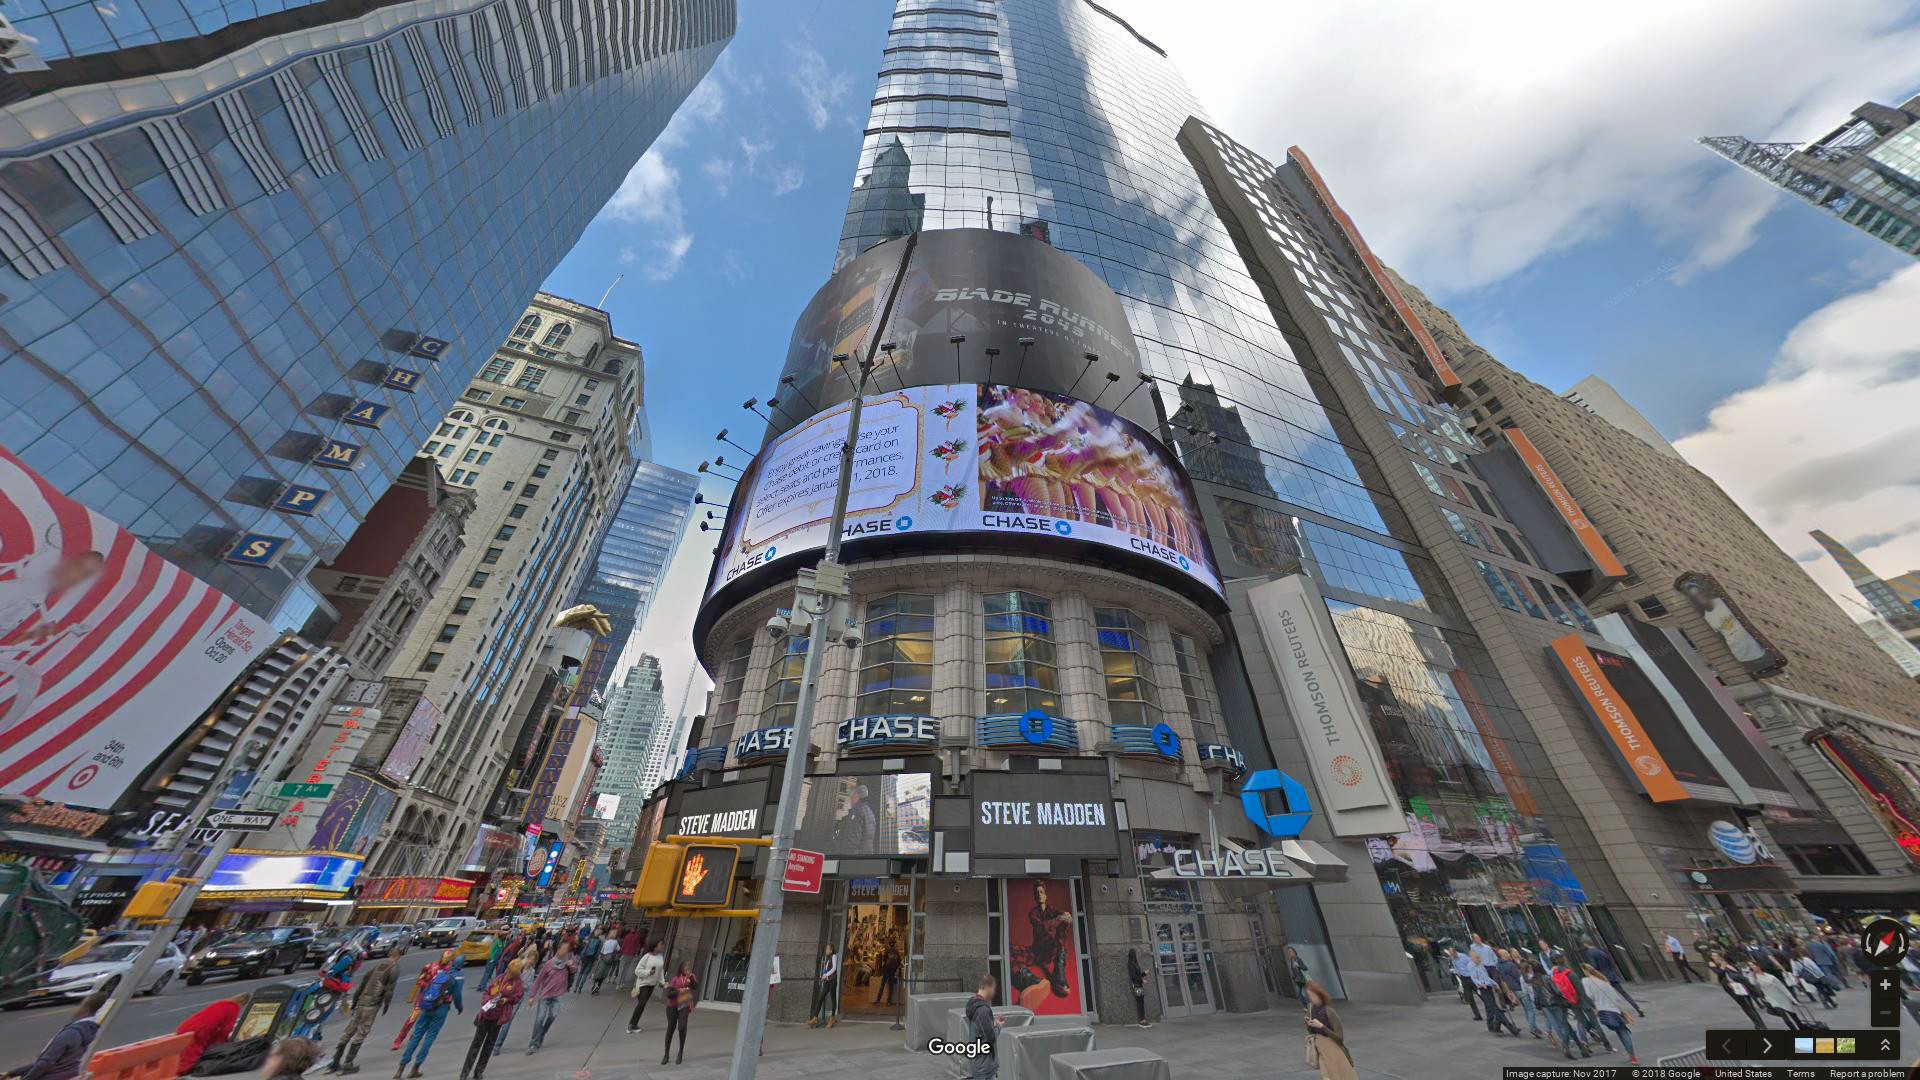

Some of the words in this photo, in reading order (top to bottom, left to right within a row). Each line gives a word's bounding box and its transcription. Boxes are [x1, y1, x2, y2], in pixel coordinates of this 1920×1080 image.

[856, 440, 881, 453] card
[884, 438, 899, 449] on
[857, 431, 873, 441] se
[874, 425, 900, 441] your
[802, 467, 821, 484] and
[809, 479, 839, 497] Janua
[865, 465, 898, 480] 2018.
[841, 519, 893, 537] HASE
[982, 514, 1053, 532] CHASE
[1130, 537, 1179, 565] CHASE
[726, 553, 764, 582] CHASE
[214, 636, 236, 656] Opens
[1278, 608, 1310, 669] REUTERS
[1572, 655, 1605, 698] REUTERS
[1302, 670, 1340, 747] THOMSON
[837, 716, 937, 746] CHASE
[1599, 698, 1641, 751] THOMSON
[736, 728, 795, 757] HASE
[1208, 744, 1246, 769] CHA
[294, 784, 303, 796] 7
[213, 815, 236, 824] ONE
[243, 816, 269, 825] WAY
[679, 813, 711, 836] STEVE
[710, 809, 758, 833] MADDEN
[981, 800, 1031, 826] STEVE
[1037, 801, 1106, 827] MADDEN
[788, 862, 805, 873] Anytime
[797, 853, 817, 865] STANDING
[1173, 848, 1292, 877] CHASE
[851, 883, 876, 897] STEVE
